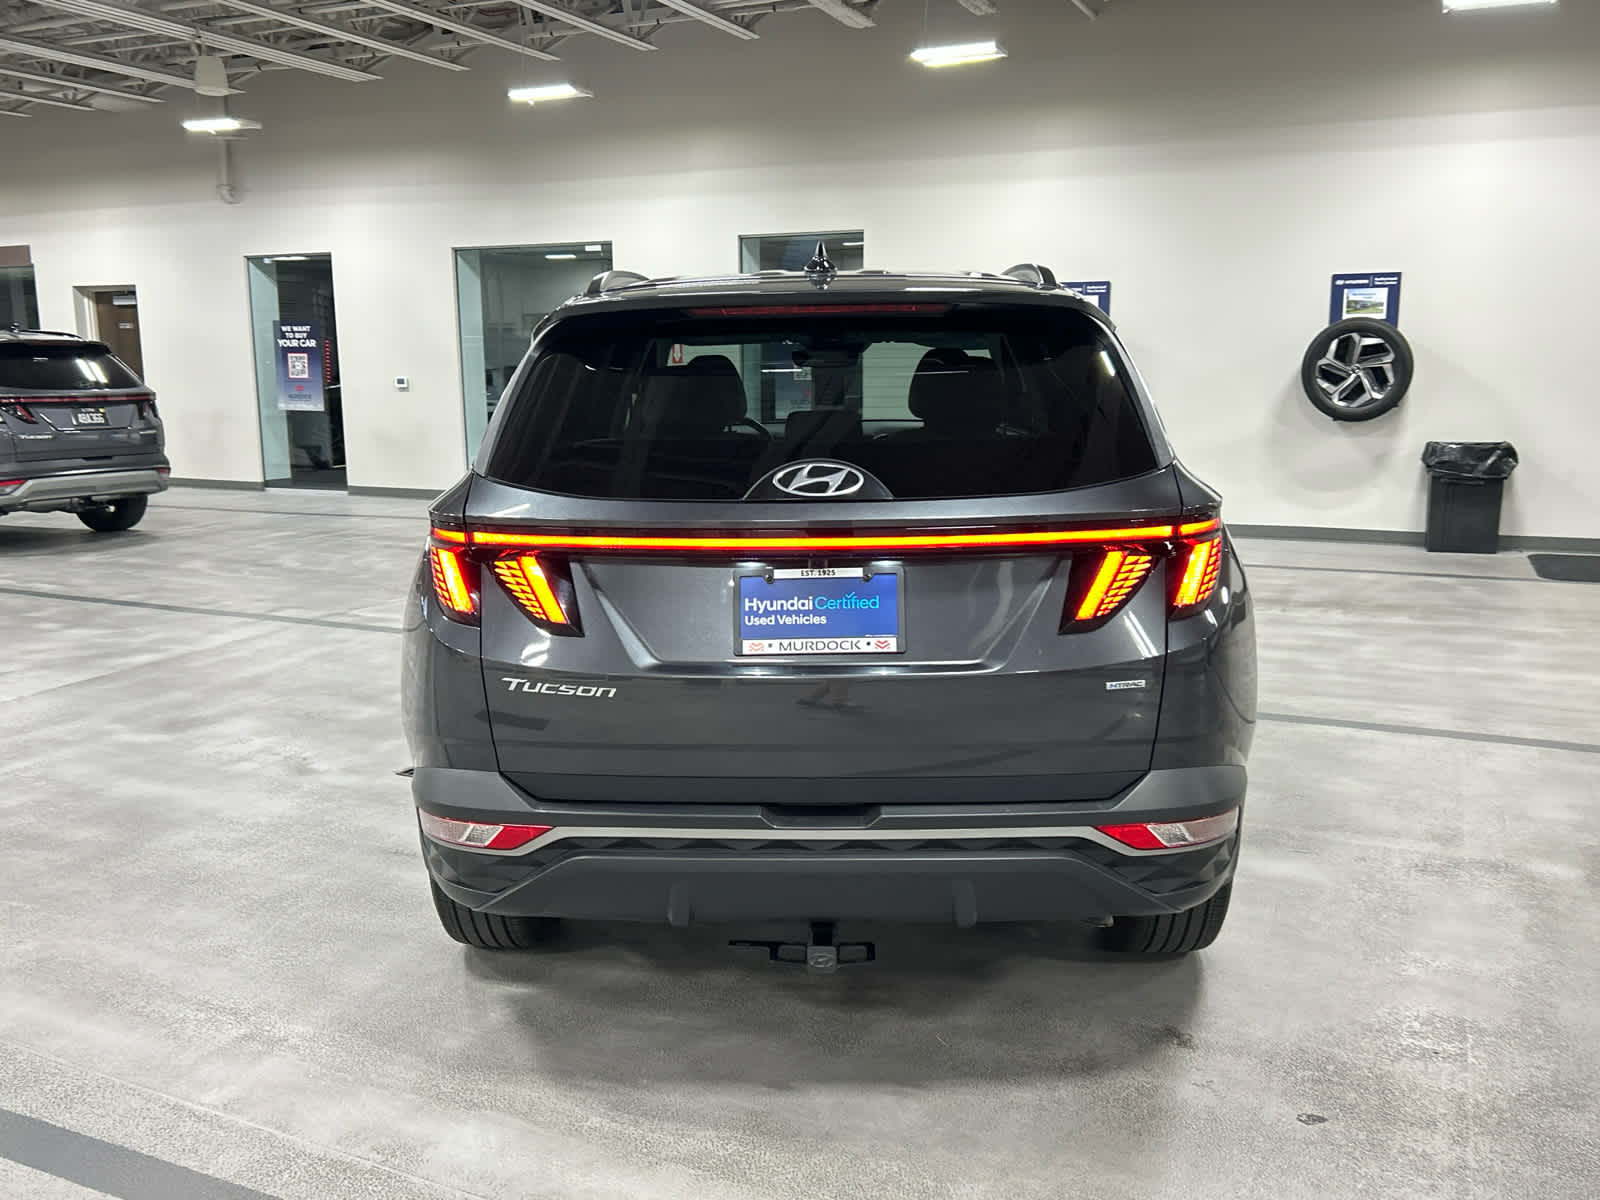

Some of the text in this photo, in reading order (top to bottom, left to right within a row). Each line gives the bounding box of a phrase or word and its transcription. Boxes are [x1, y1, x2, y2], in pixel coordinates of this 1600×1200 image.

[277, 339, 317, 347] YOUR CAR
[800, 569, 836, 577] EST. 1925
[744, 592, 880, 614] Hyundai Certified
[744, 613, 827, 625] Used Vehicles
[779, 640, 862, 651] MURDOCK
